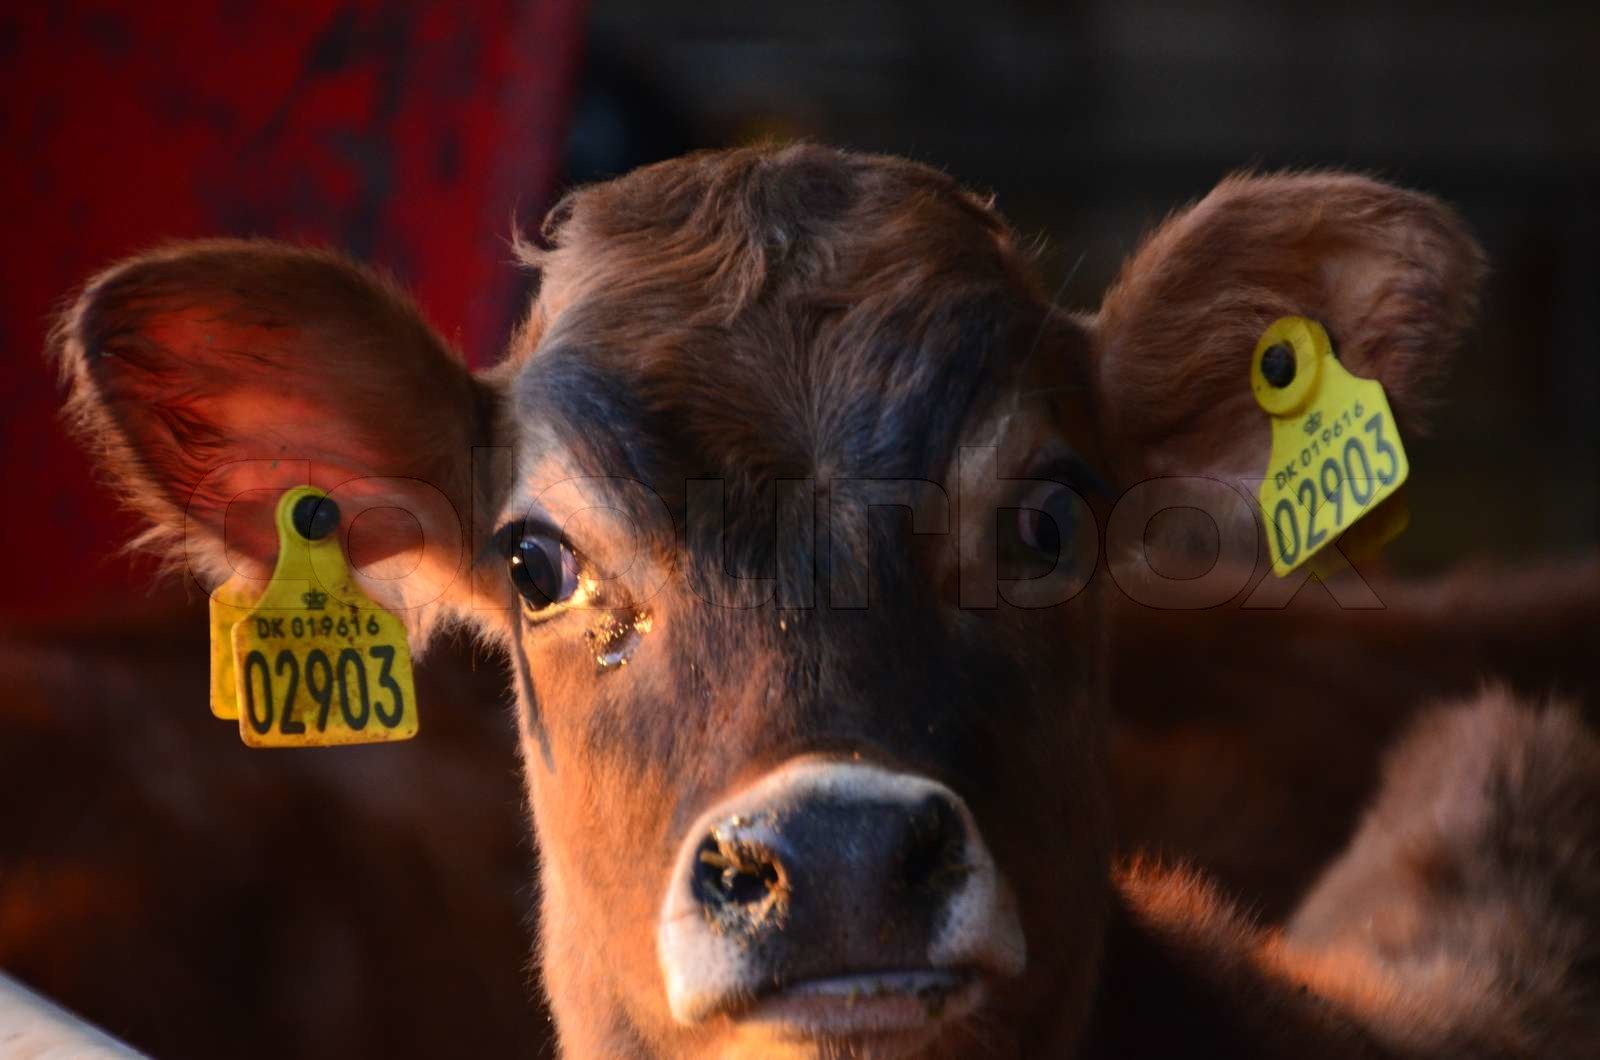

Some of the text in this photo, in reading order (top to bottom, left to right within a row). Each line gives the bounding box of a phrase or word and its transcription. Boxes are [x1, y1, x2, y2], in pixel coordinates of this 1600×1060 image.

[1273, 411, 1399, 566] 02903
[1274, 401, 1364, 491] DK 019616
[255, 614, 381, 640] DK 019616
[244, 644, 405, 736] 02903
